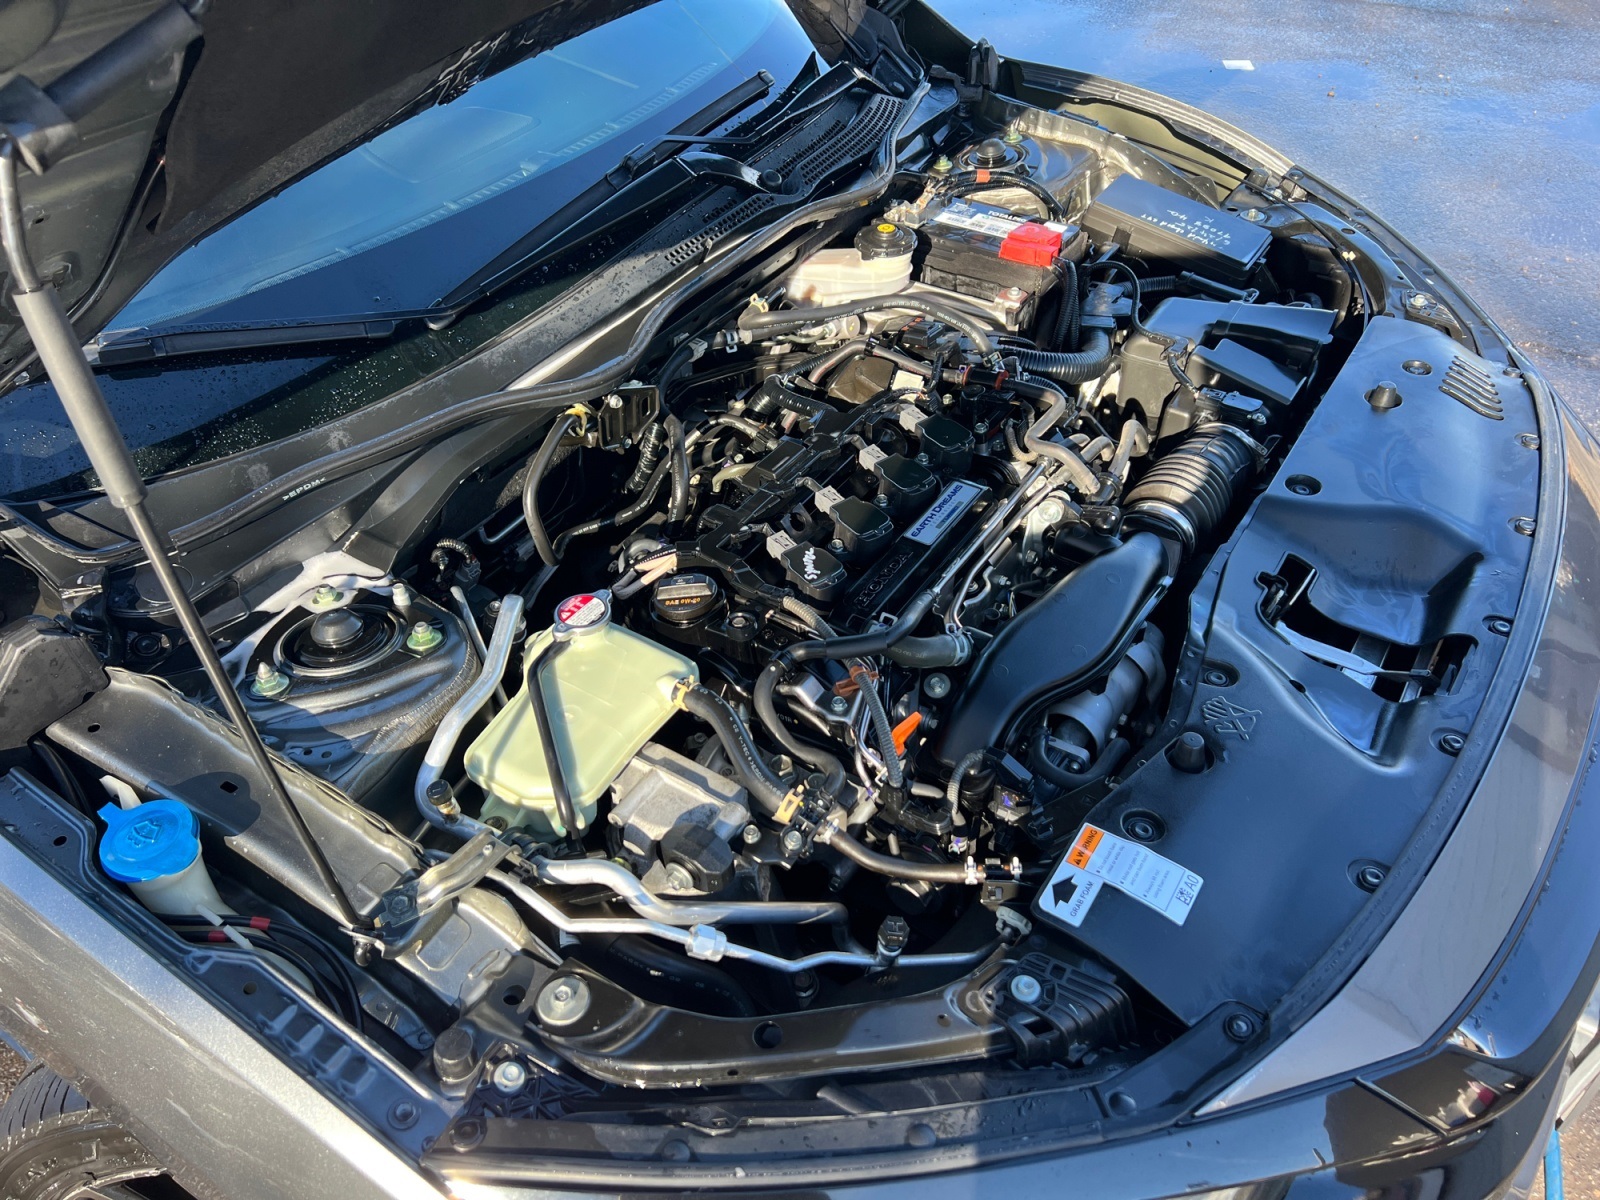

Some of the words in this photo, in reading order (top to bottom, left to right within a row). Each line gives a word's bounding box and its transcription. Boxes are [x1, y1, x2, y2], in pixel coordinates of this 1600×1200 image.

[911, 509, 935, 537] EARTH
[933, 484, 963, 516] DREAMS
[854, 551, 914, 606] HONDA
[1070, 898, 1083, 917] GRAB
[1079, 880, 1093, 900] FOAM
